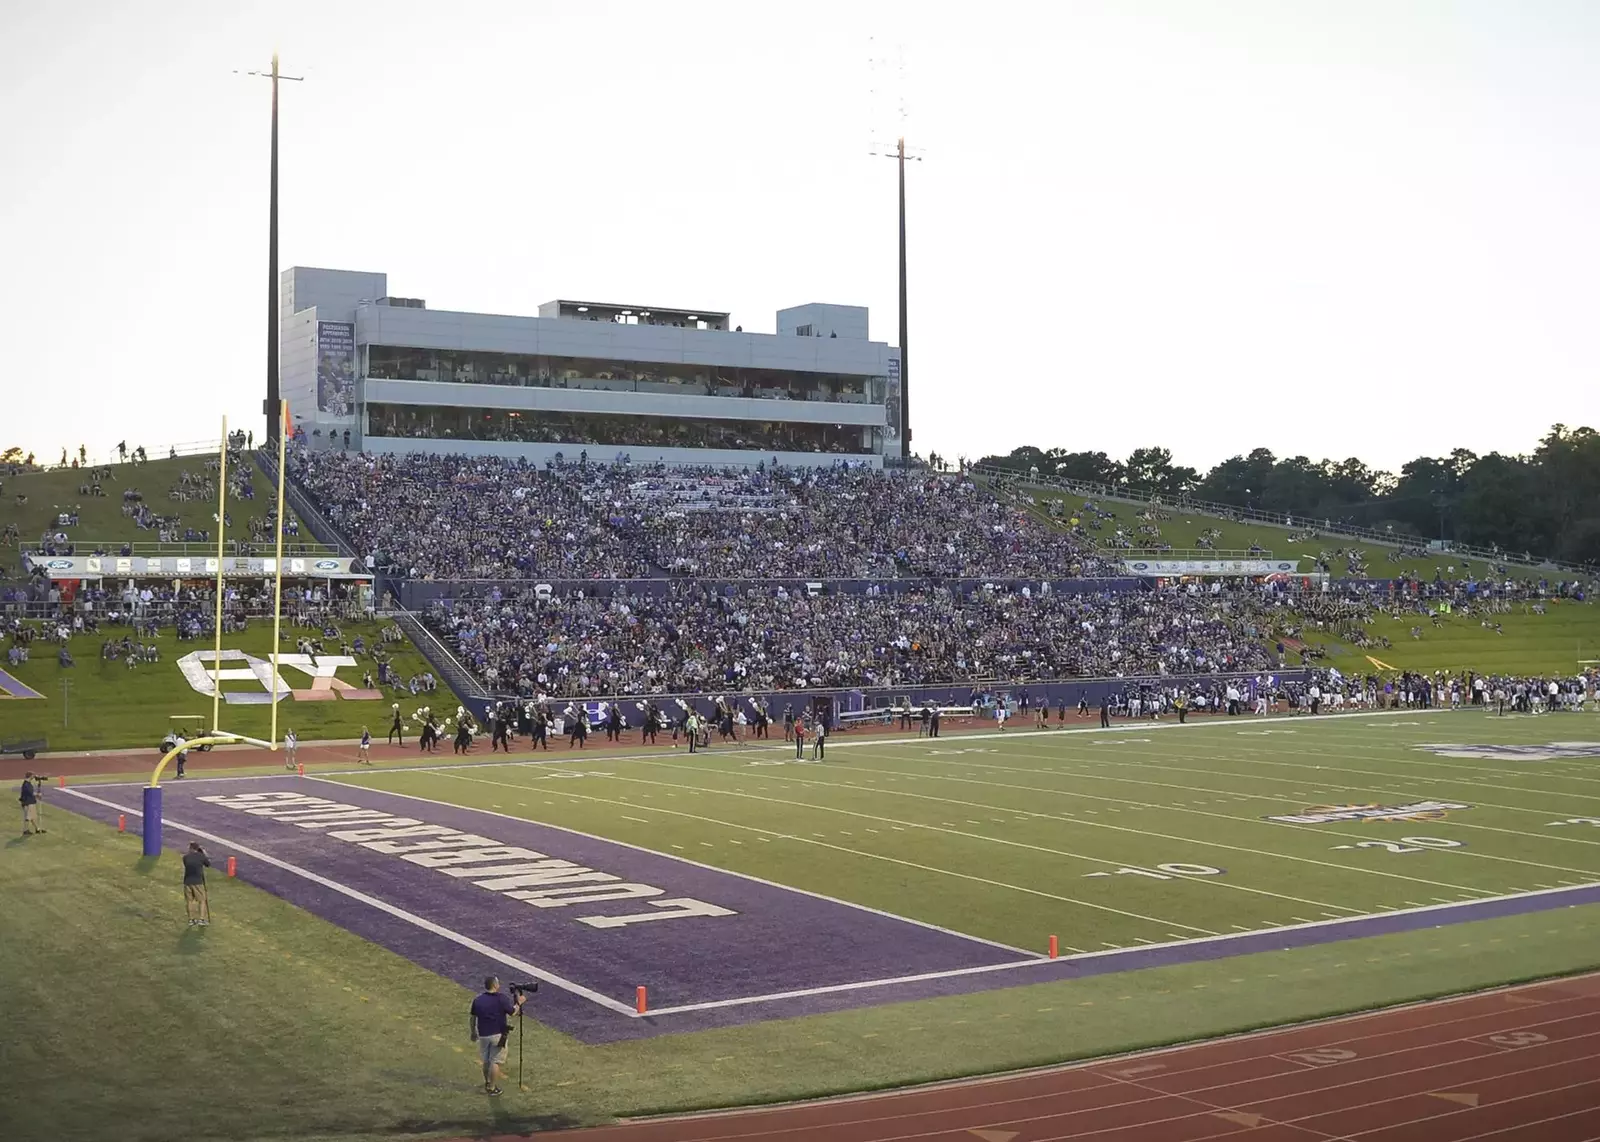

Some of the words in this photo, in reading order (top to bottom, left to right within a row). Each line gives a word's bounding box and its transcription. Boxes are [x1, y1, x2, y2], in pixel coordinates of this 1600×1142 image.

[1356, 836, 1462, 853] 20
[196, 791, 738, 929] LUMBERJACKS
[1114, 863, 1221, 880] 10
[1490, 1031, 1548, 1045] 3
[1289, 1048, 1357, 1064] 2
